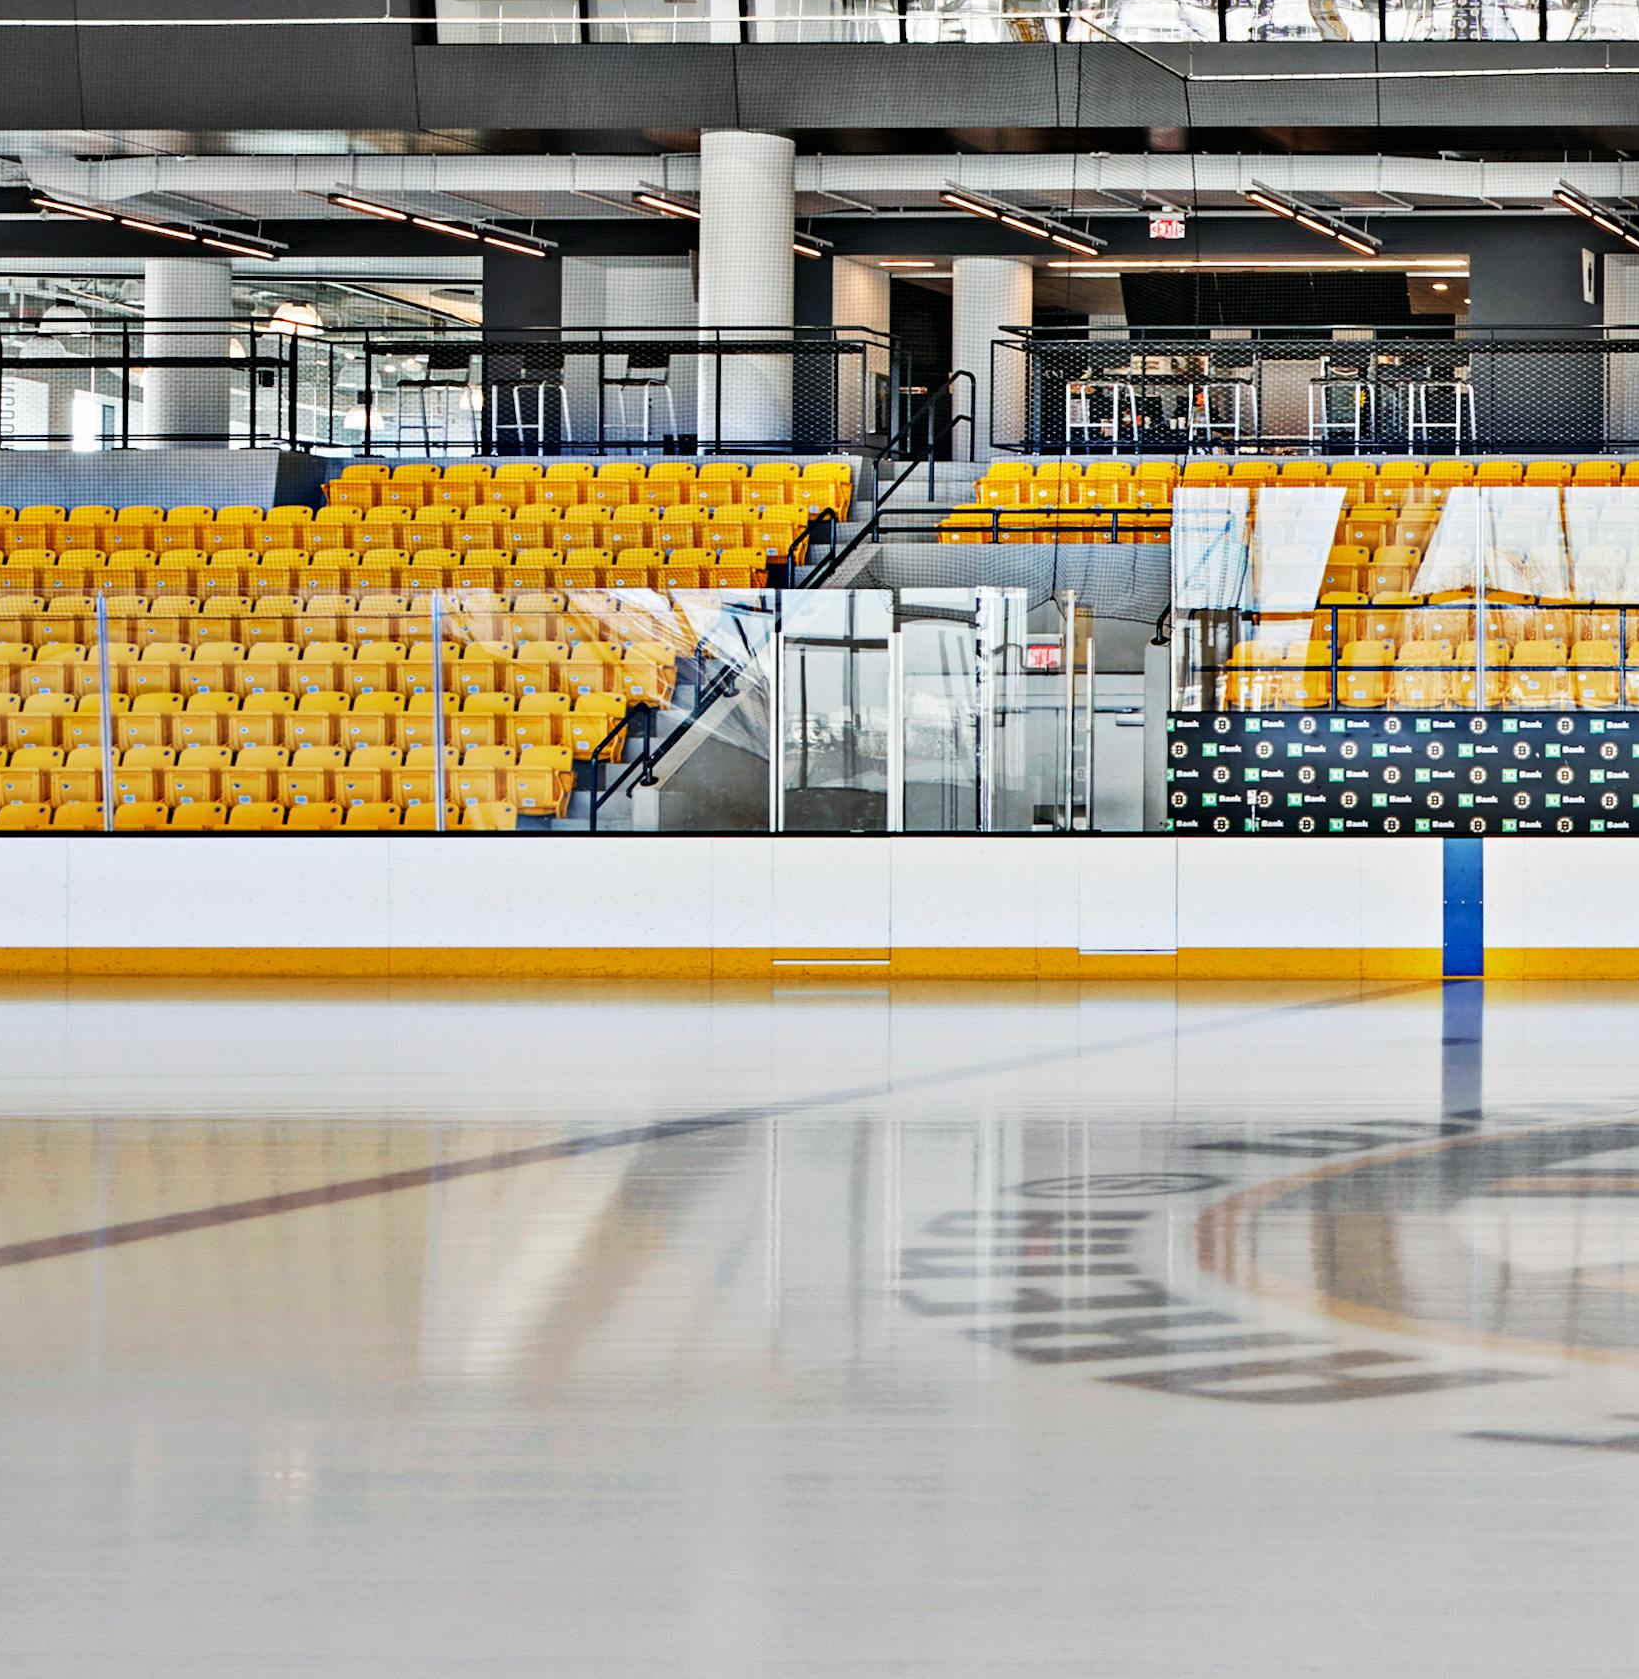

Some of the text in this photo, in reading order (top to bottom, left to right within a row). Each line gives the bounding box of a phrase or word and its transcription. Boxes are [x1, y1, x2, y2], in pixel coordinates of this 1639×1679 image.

[1346, 819, 1369, 828] Bank
[1432, 819, 1455, 828] Bank
[1519, 820, 1542, 829] Bank
[1607, 820, 1630, 829] Bank
